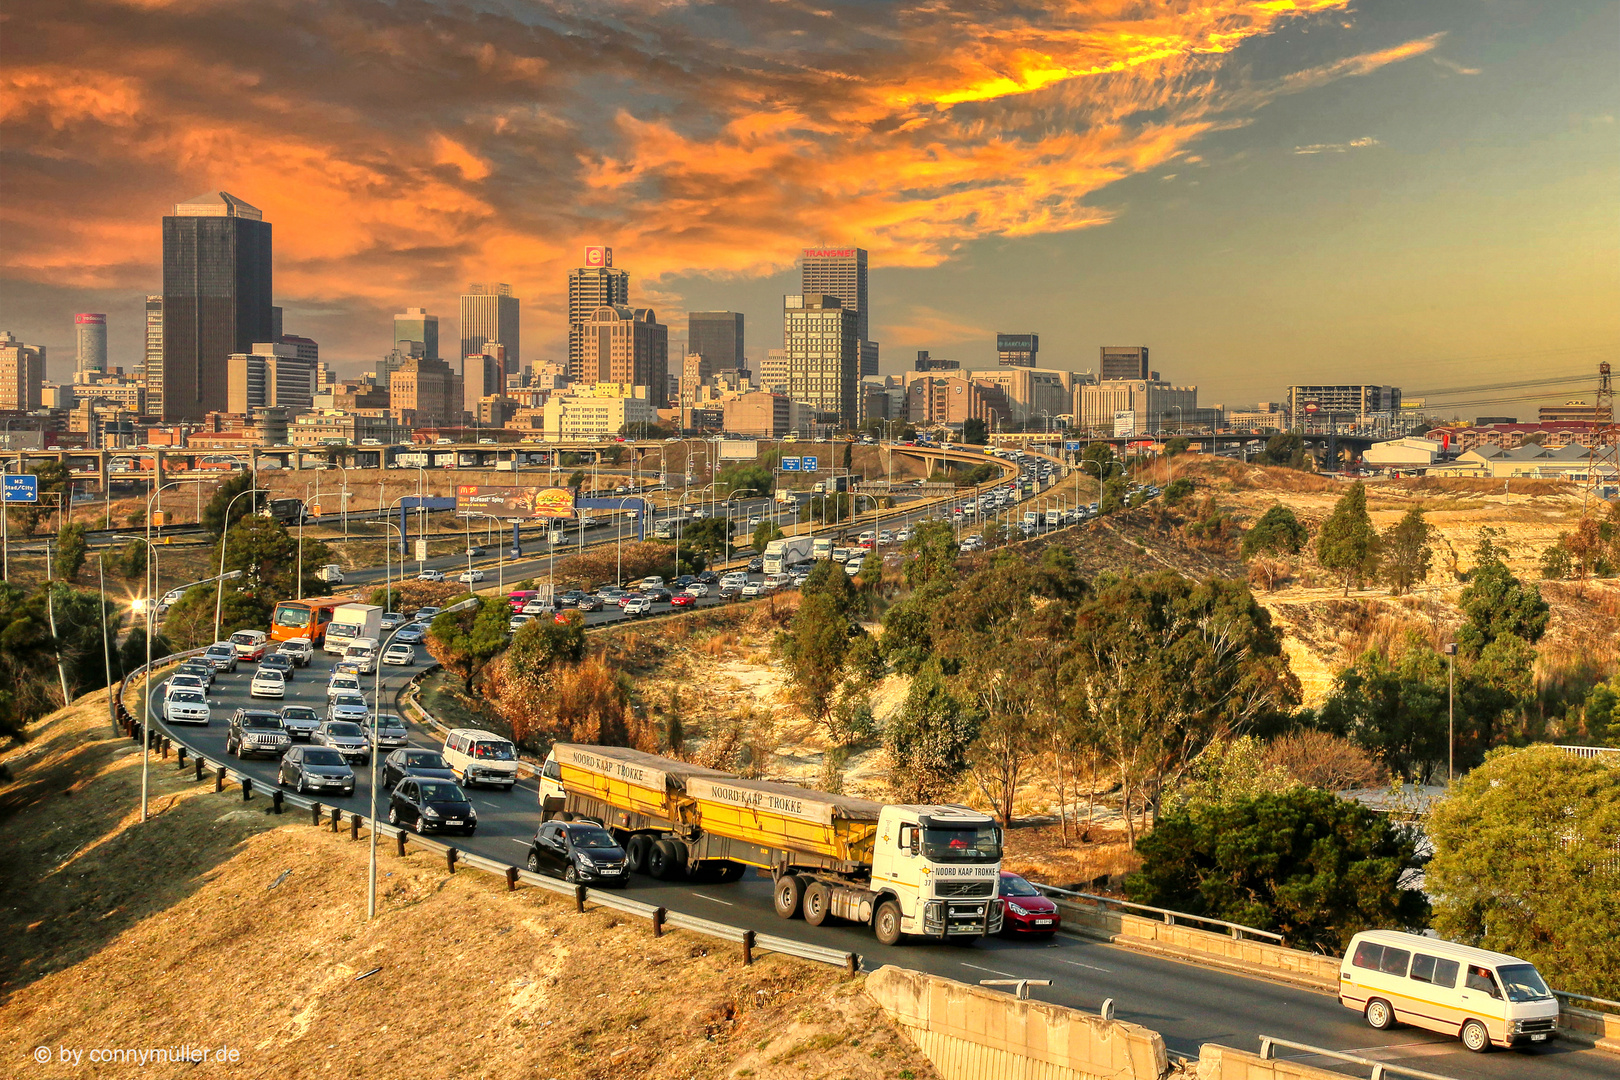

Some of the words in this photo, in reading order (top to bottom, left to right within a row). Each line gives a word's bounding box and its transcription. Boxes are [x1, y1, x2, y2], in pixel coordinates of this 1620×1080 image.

[588, 249, 602, 264] e
[606, 250, 612, 264] e
[803, 249, 856, 257] TRANSNET
[573, 751, 595, 768] NOORD
[595, 757, 613, 773] KAAP
[616, 764, 644, 781] TROKKE
[711, 785, 739, 801] NOORD
[741, 790, 763, 805] KAAP
[768, 795, 802, 813] TROKKE
[935, 867, 957, 876] NOORD
[957, 867, 973, 876] KAAP
[974, 867, 996, 876] TROKKE
[924, 879, 932, 887] 37
